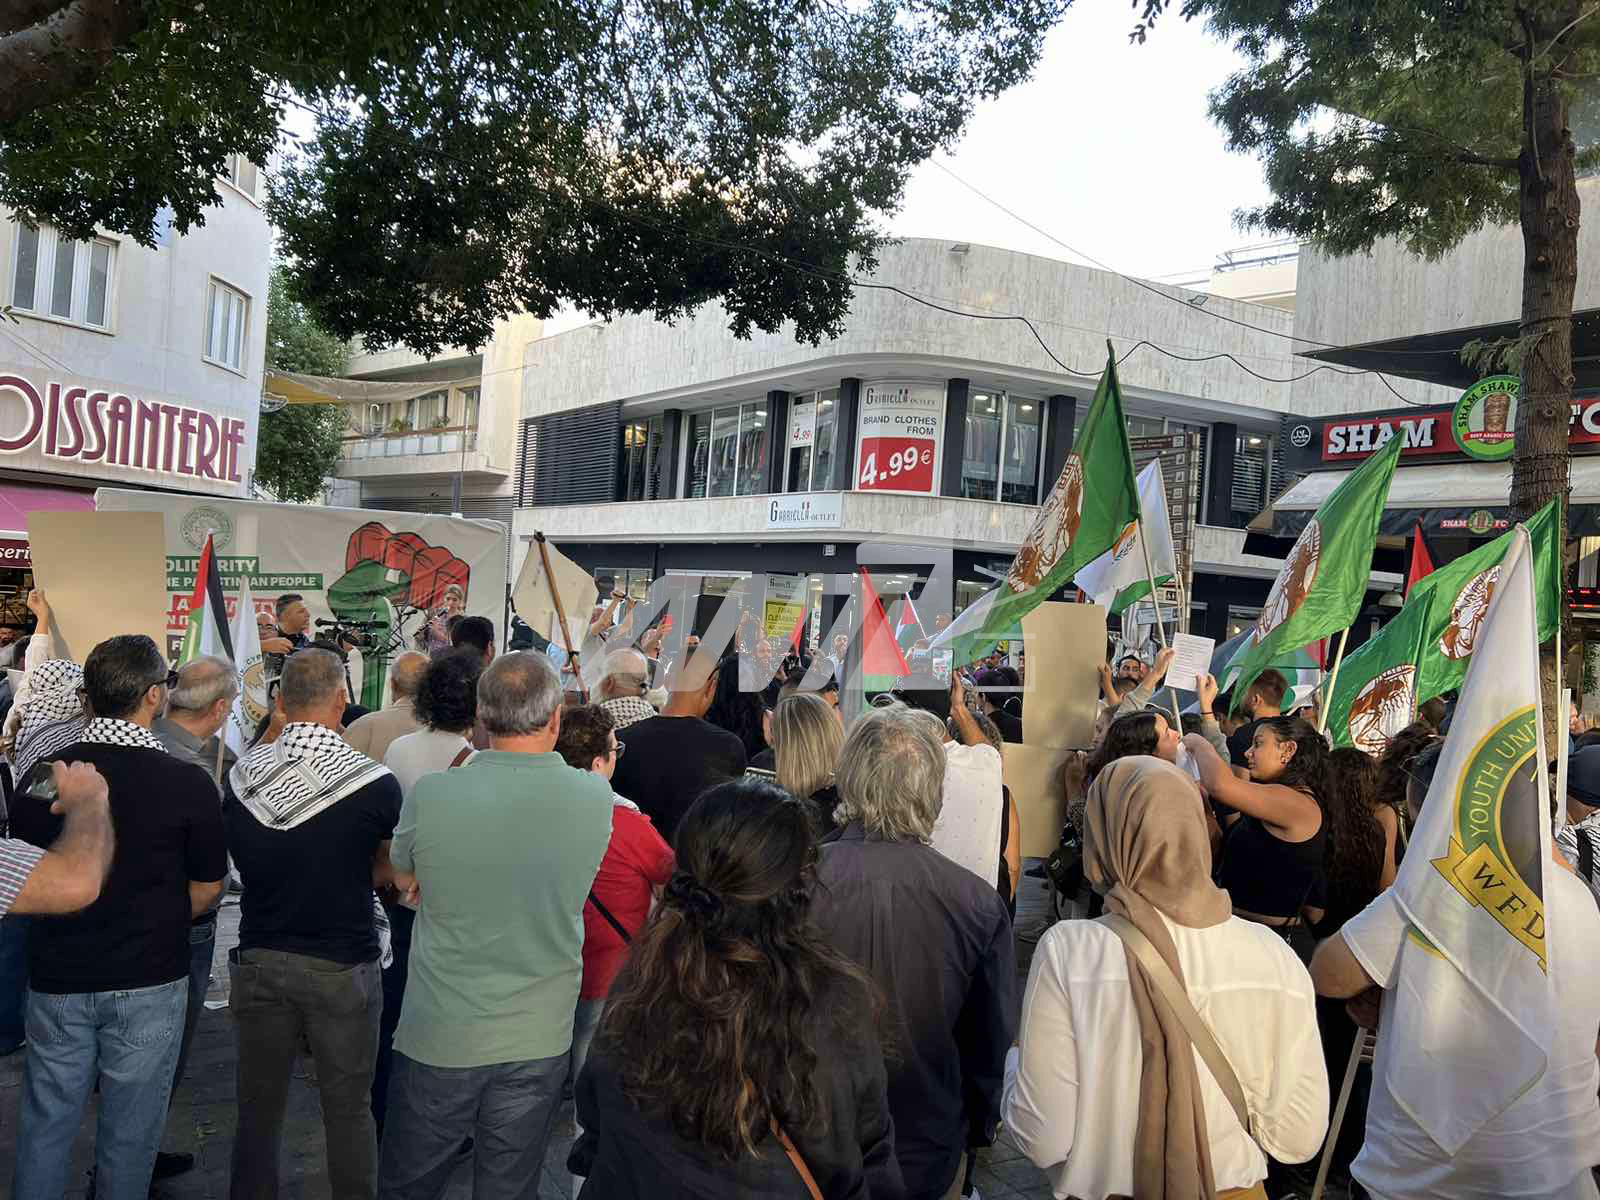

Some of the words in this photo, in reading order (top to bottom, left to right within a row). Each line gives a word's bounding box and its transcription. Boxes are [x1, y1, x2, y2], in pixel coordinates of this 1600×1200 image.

[863, 415, 890, 425] BRAND
[894, 415, 937, 426] CLOTHES
[906, 425, 934, 435] FROM
[1327, 418, 1436, 454] SHAM
[270, 577, 316, 587] PEOPLE
[1469, 762, 1504, 838] YOUTH
